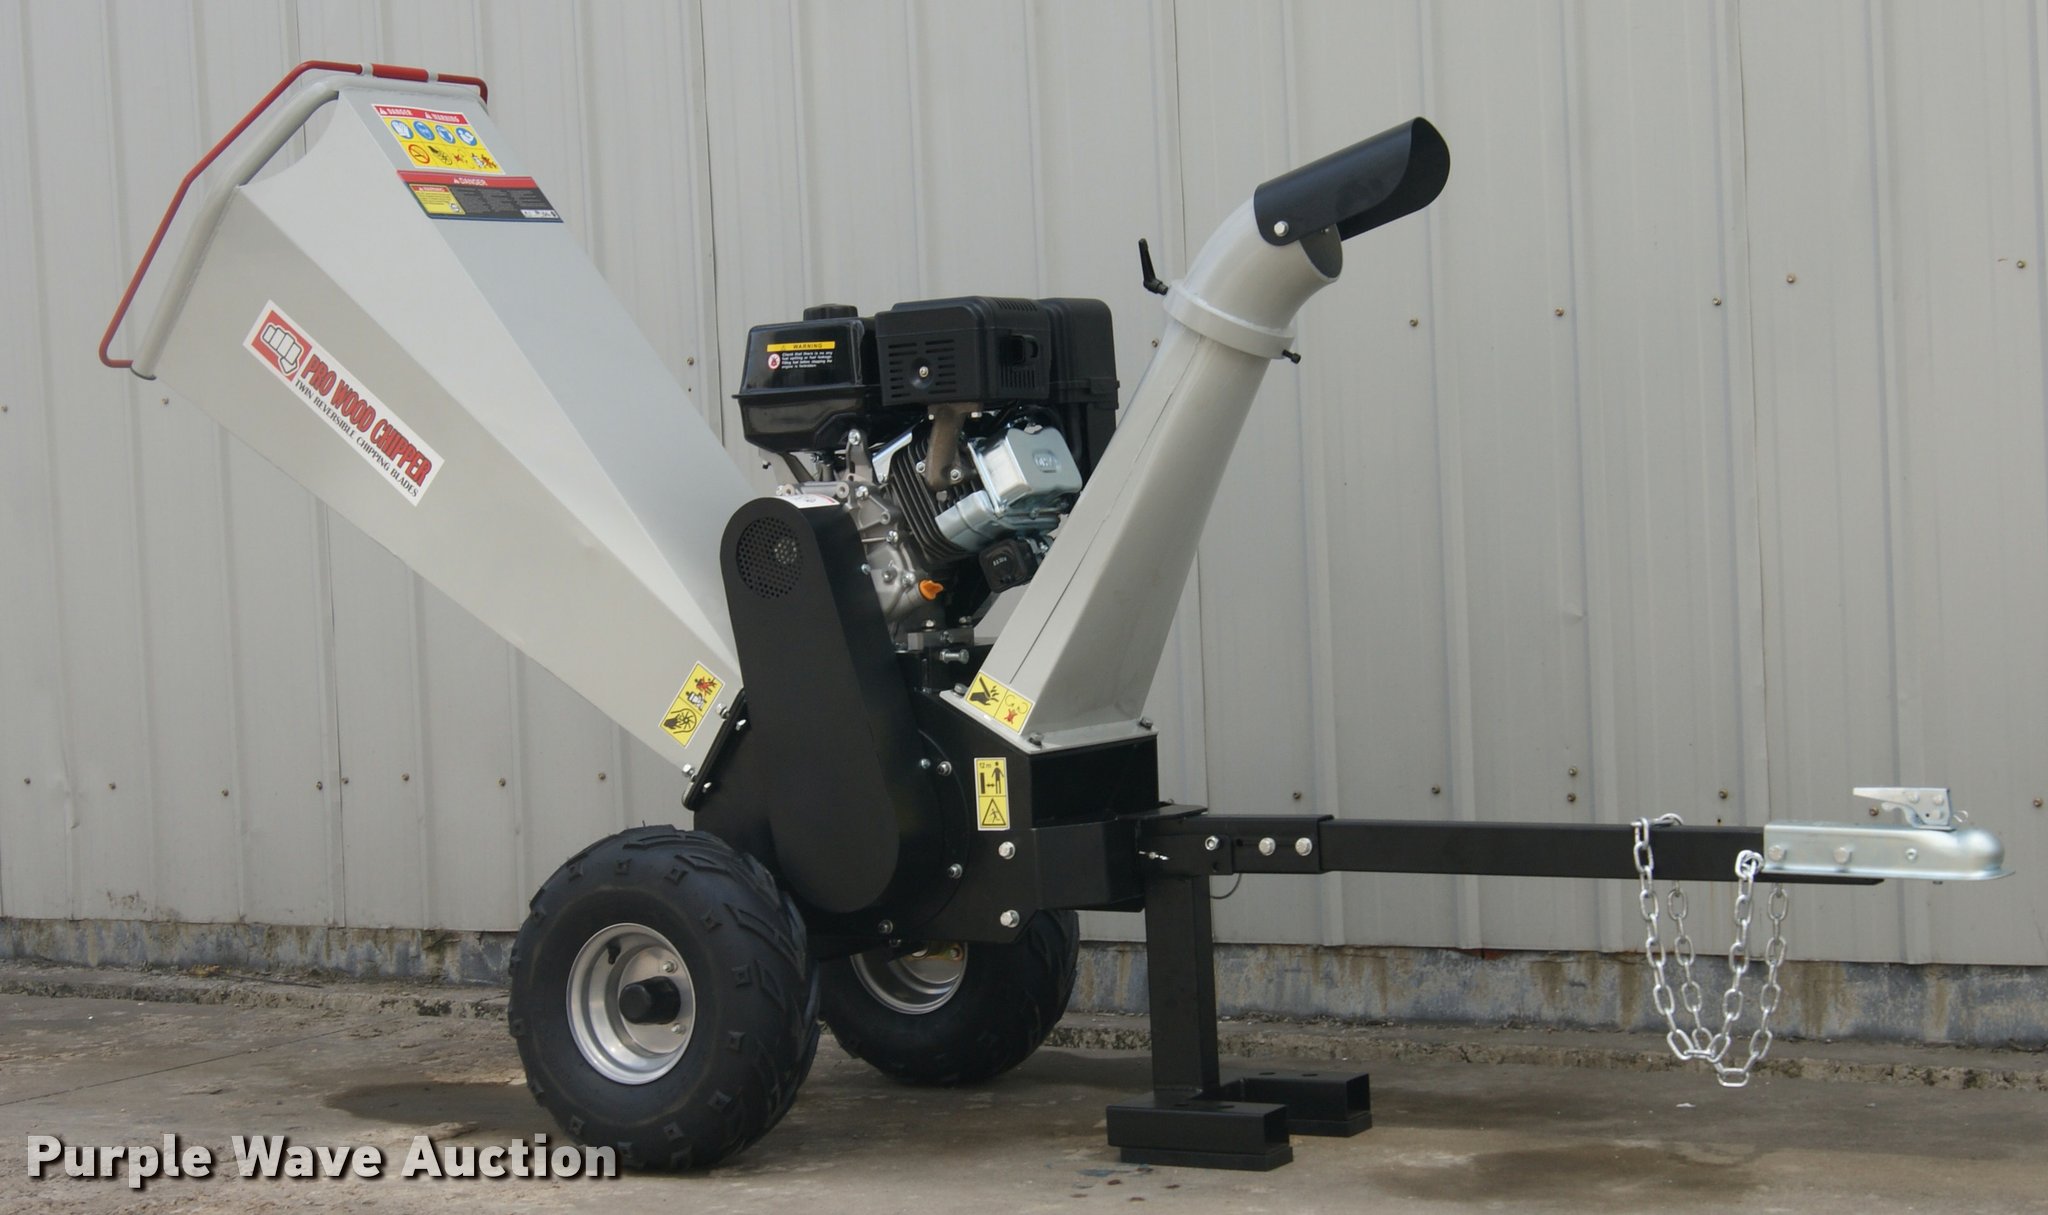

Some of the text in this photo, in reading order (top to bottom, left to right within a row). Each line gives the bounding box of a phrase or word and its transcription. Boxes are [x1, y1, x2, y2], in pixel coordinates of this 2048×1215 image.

[295, 379, 419, 497] TWIN REVERSIBLE CHIPPING BLADES
[301, 354, 432, 487] PRO WOOD CHIPPER
